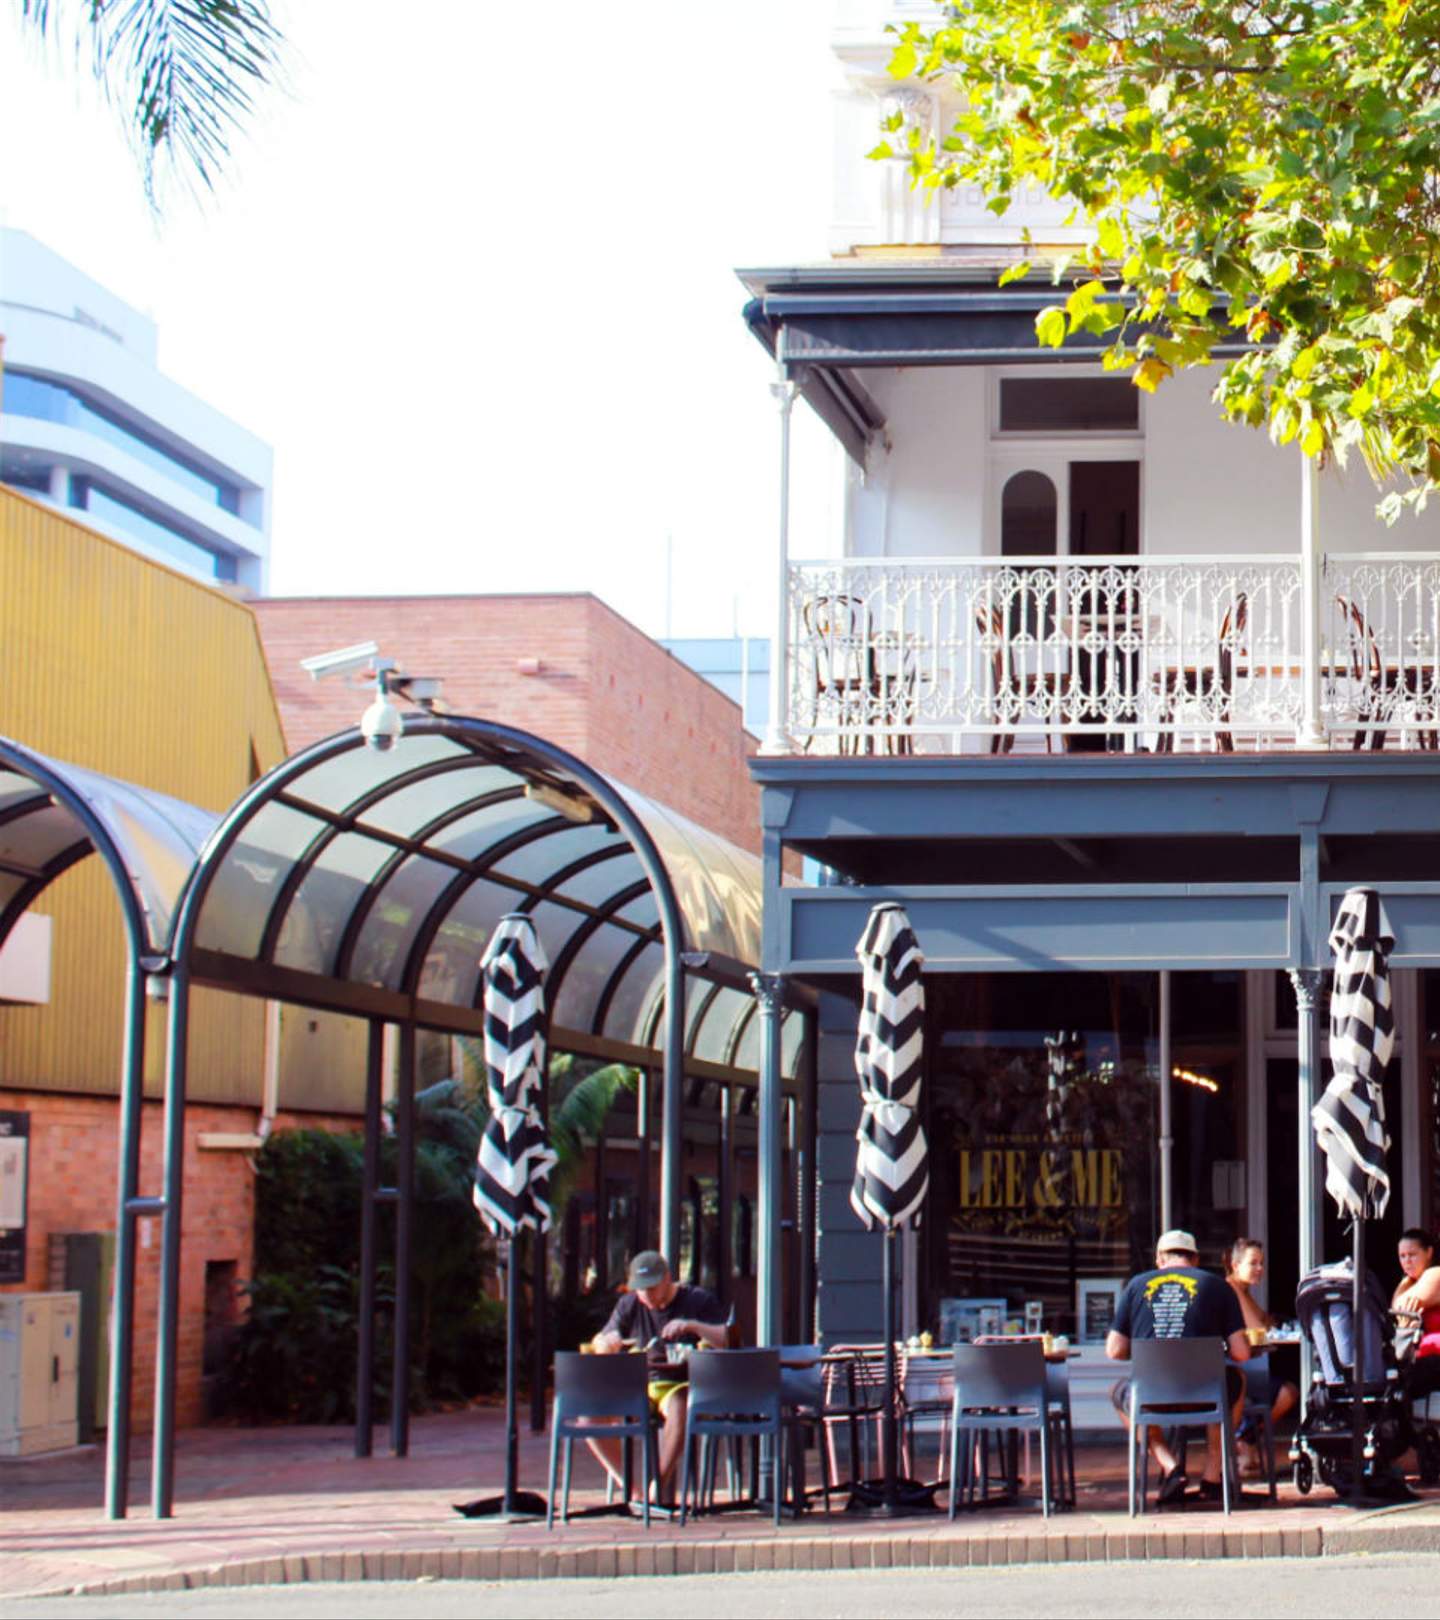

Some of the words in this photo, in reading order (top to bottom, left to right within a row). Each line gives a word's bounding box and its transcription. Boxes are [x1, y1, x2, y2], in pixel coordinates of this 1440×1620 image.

[959, 1150, 1027, 1208] LEE
[1033, 1150, 1065, 1207] &
[1071, 1149, 1123, 1208] ME
